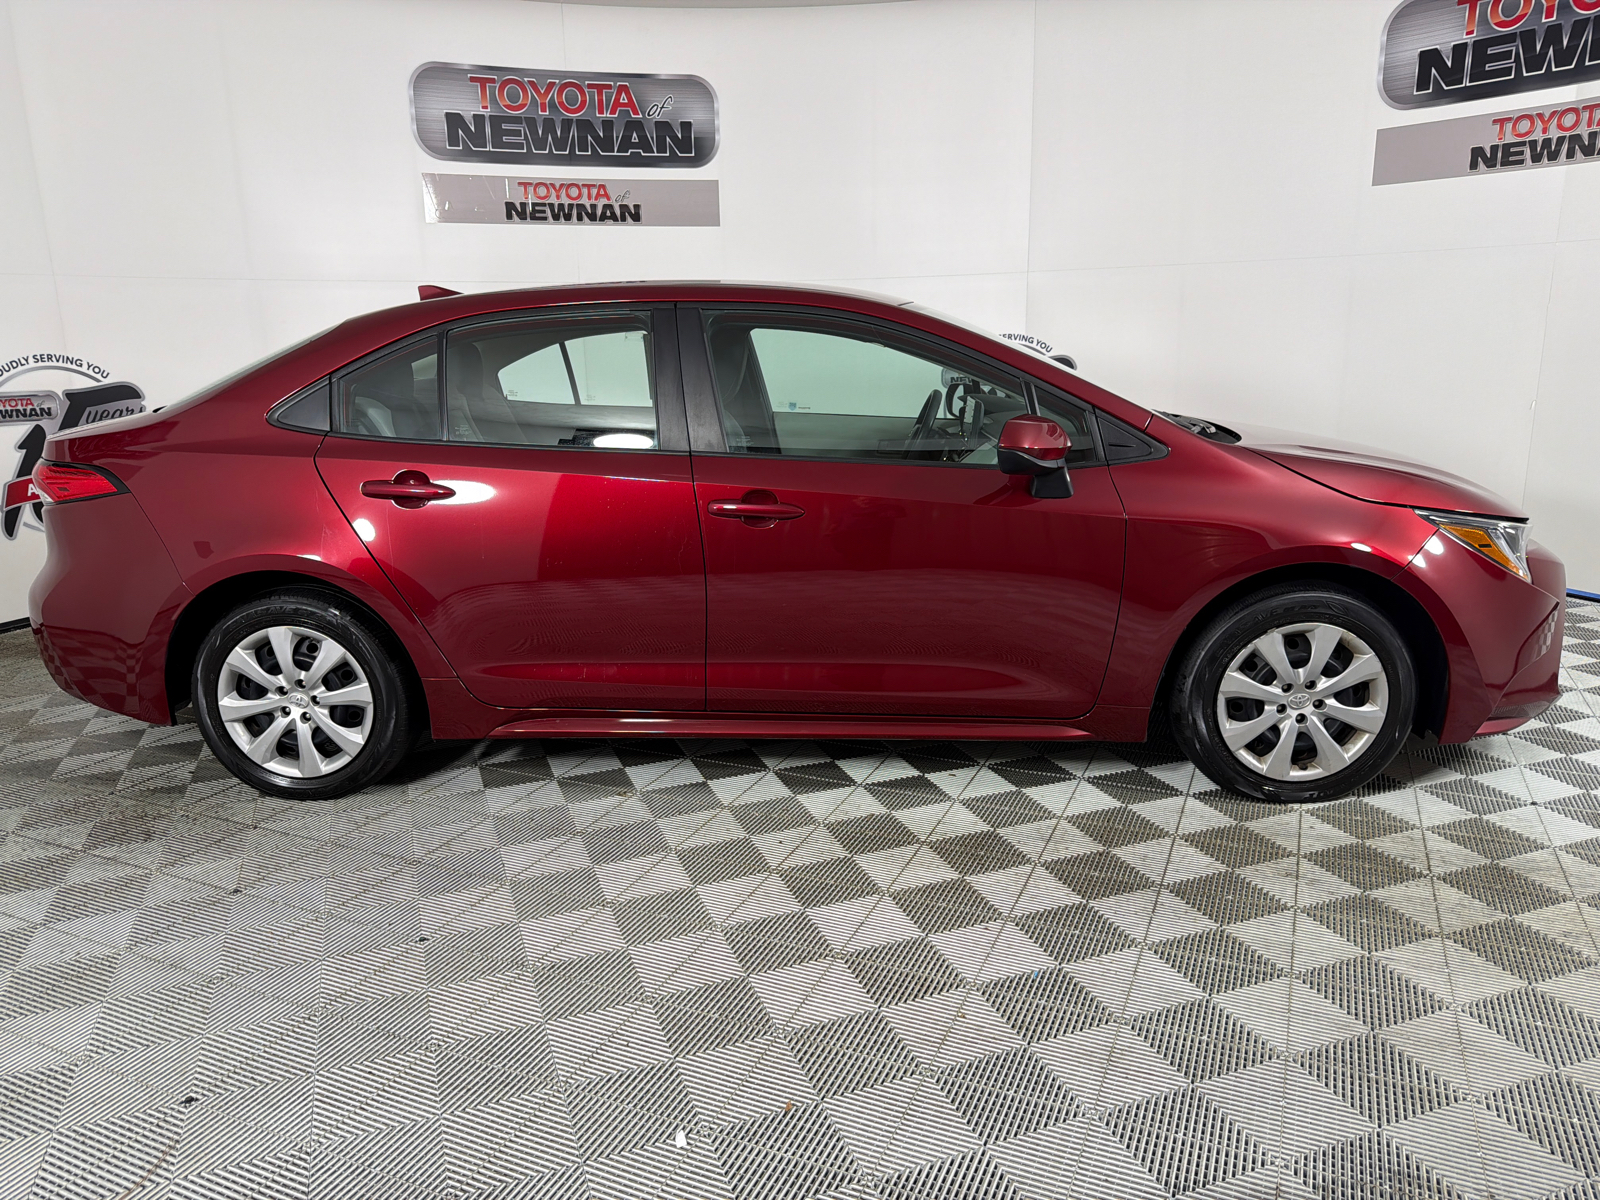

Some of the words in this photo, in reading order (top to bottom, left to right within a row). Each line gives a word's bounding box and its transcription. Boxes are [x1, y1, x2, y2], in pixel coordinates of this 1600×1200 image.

[1414, 14, 1600, 93] NEW
[468, 74, 641, 117] TOYOTA
[647, 95, 673, 118] of
[445, 112, 694, 156] NEWNAN
[1469, 130, 1600, 171] NEWN
[517, 181, 612, 201] TOYOTA
[614, 189, 630, 203] of
[505, 201, 642, 222] NEWNAN
[998, 333, 1035, 344] ERVING
[1035, 338, 1053, 353] YOU
[32, 353, 84, 368] SERVING
[86, 361, 110, 379] YOU
